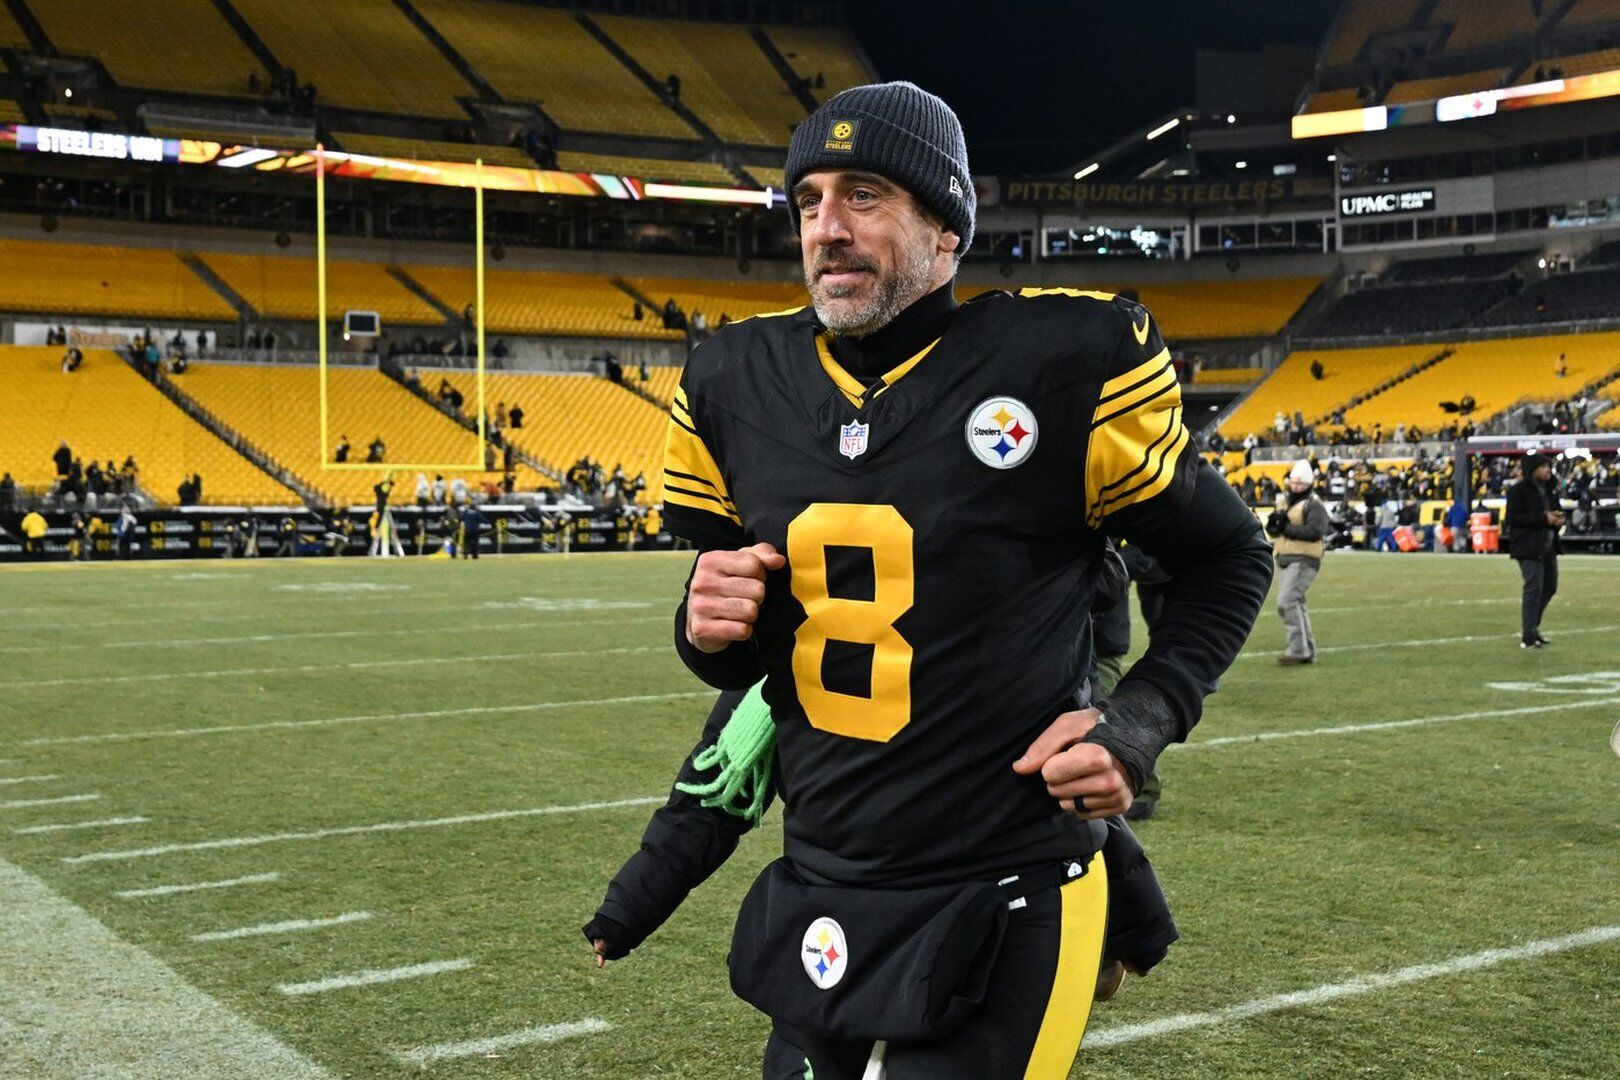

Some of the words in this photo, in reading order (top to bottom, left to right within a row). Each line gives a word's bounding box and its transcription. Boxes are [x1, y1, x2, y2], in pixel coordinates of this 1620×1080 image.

[37, 127, 128, 159] STEELERS
[1008, 181, 1154, 203] PITTSBURGH
[1162, 180, 1285, 203] STEELERS
[1342, 194, 1396, 215] UPMC
[974, 426, 1001, 436] Steelers
[844, 438, 863, 451] NFL
[787, 503, 914, 743] 8
